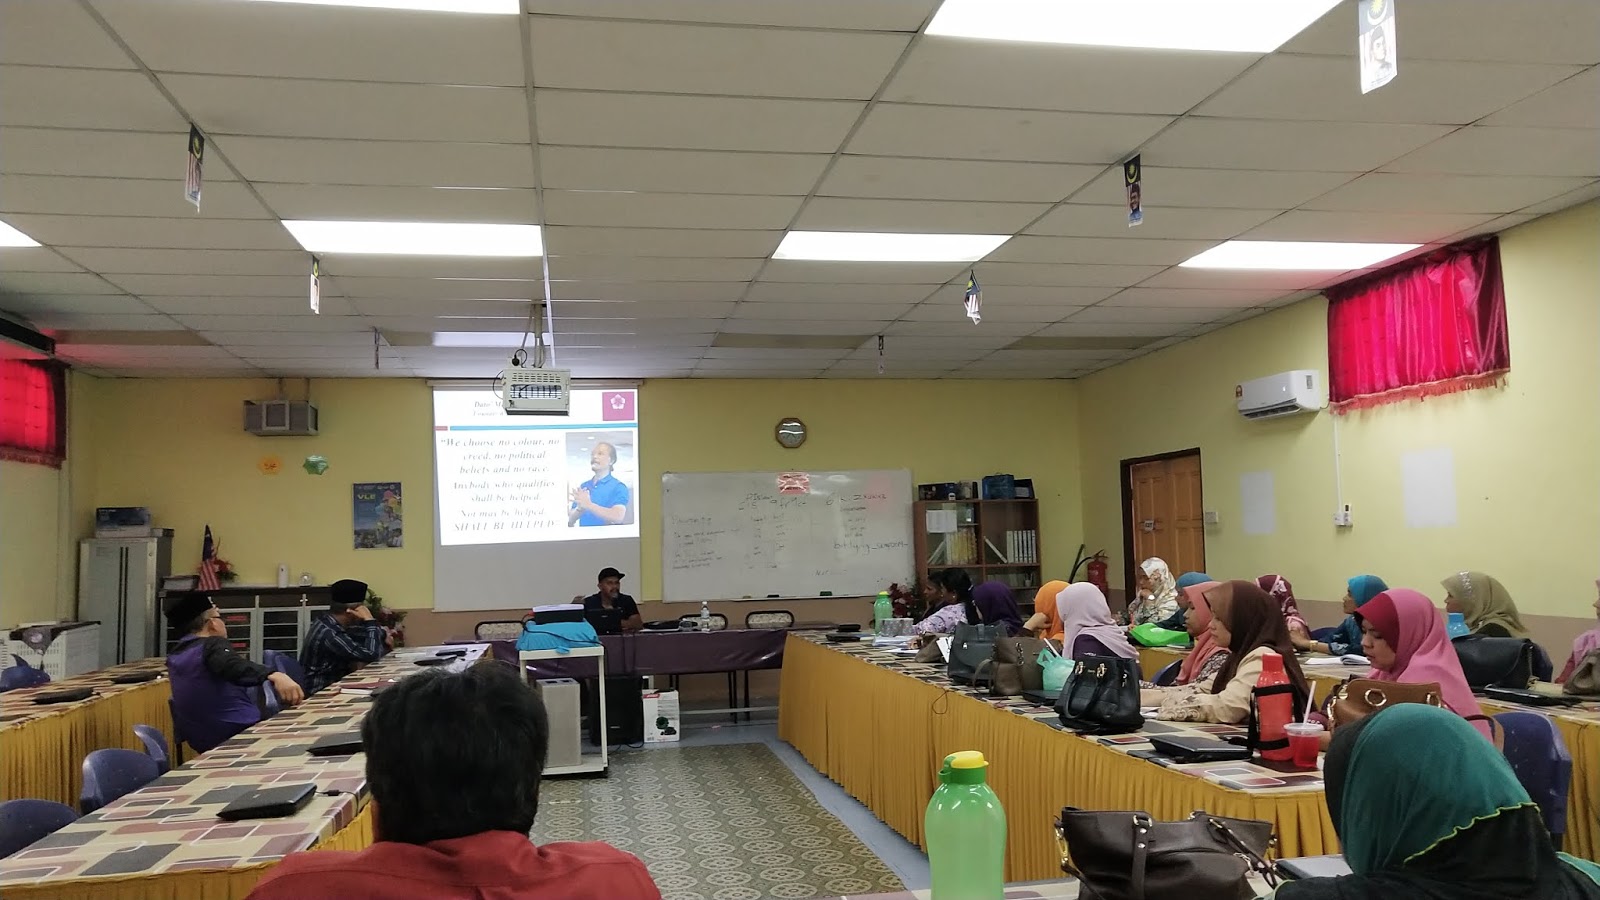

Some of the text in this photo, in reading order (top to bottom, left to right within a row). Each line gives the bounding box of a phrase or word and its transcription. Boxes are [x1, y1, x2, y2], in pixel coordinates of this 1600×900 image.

[463, 438, 496, 446] choose
[508, 450, 546, 461] political
[460, 466, 490, 474] beliefs
[493, 465, 510, 474] and
[454, 481, 490, 490] Anybody
[516, 479, 556, 490] qualifies
[471, 494, 493, 502] shall
[496, 494, 505, 502] be
[454, 522, 488, 532] SHALL
[494, 522, 505, 530] BE
